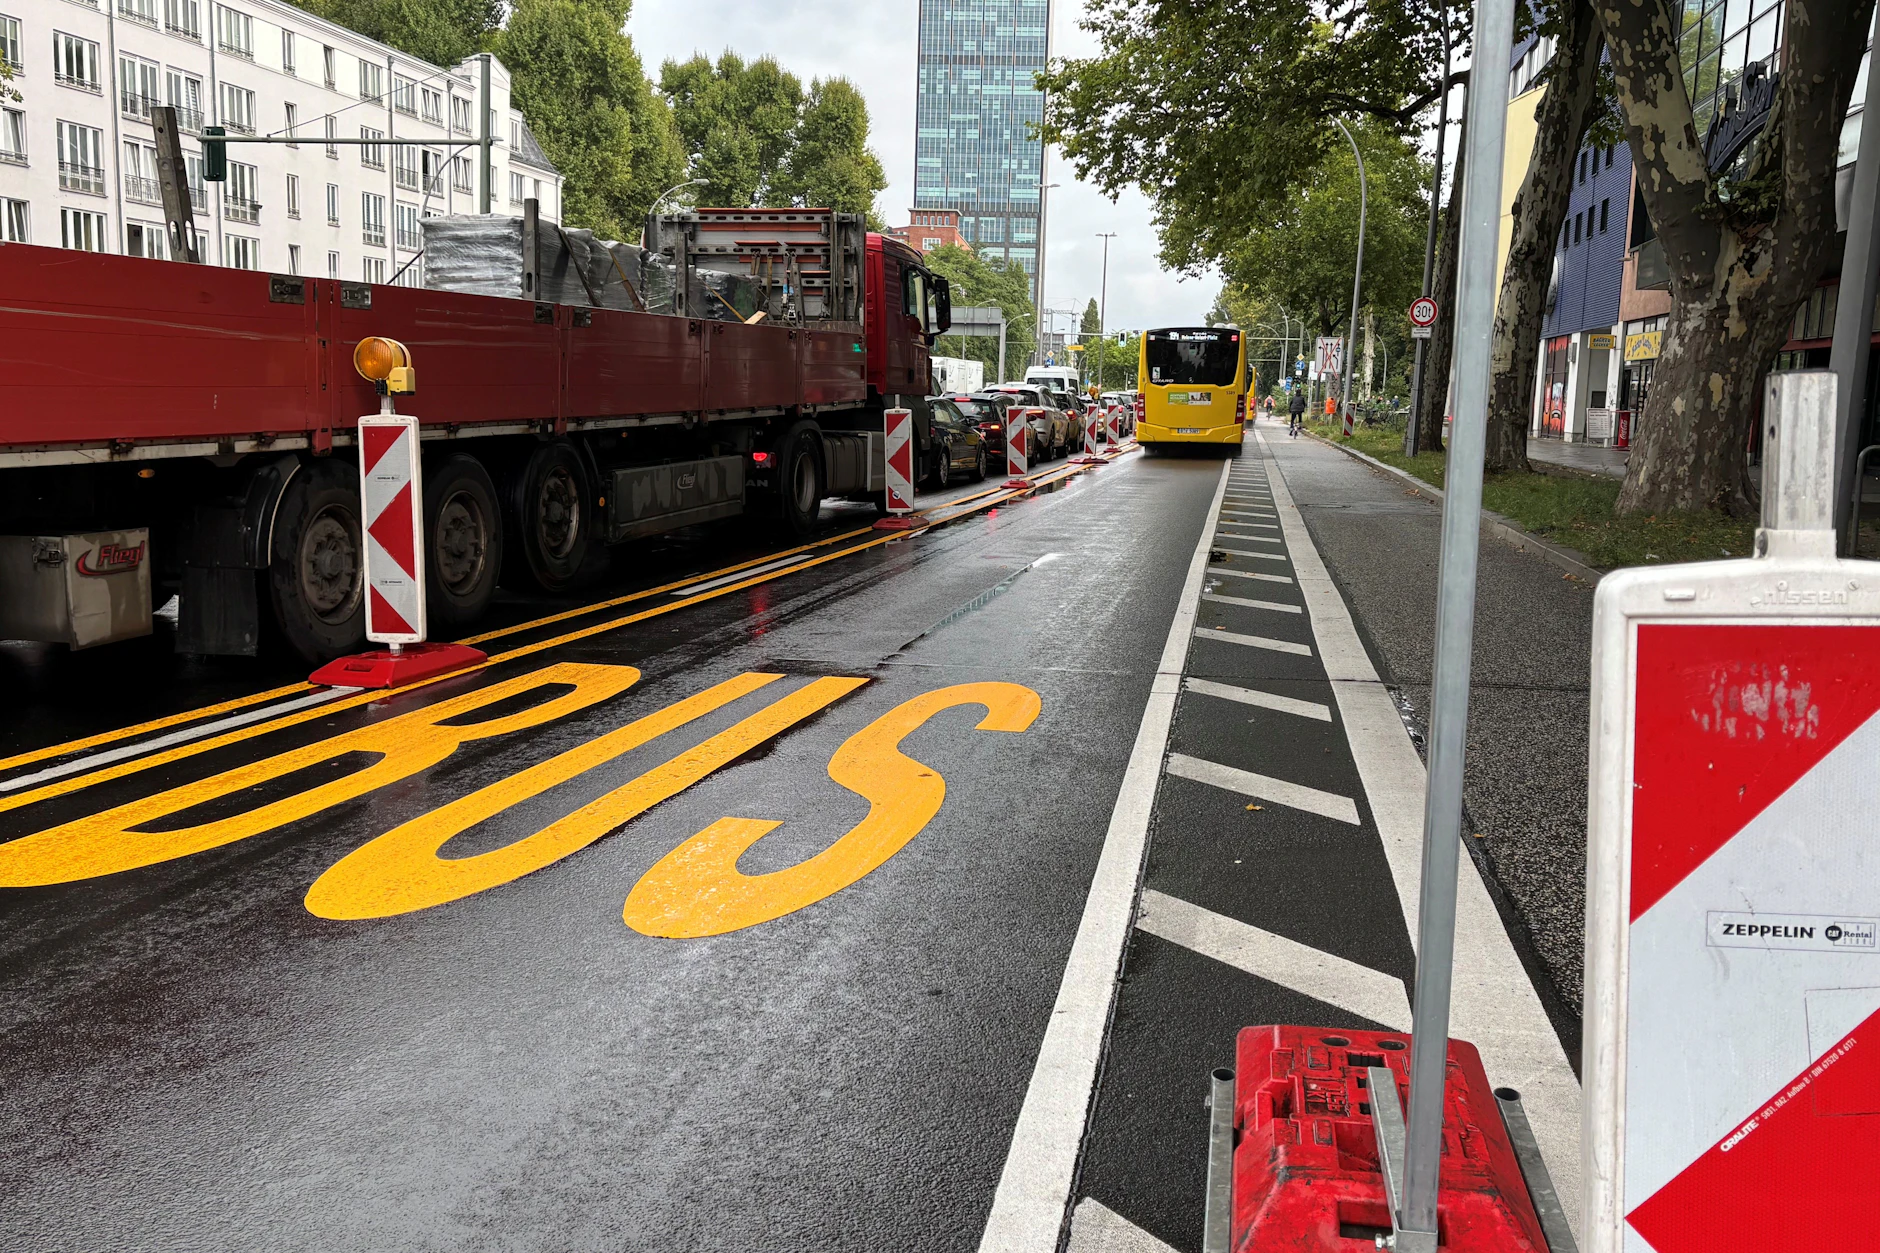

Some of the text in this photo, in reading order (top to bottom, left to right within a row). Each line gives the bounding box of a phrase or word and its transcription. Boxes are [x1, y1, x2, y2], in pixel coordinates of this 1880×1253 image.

[1415, 305, 1431, 318] 30t
[96, 539, 145, 568] Fliegl
[1763, 589, 1848, 605] nissen
[0, 662, 1041, 939] BUS
[1722, 923, 1814, 939] ZEPPELIN
[1811, 1065, 1825, 1078] DIN
